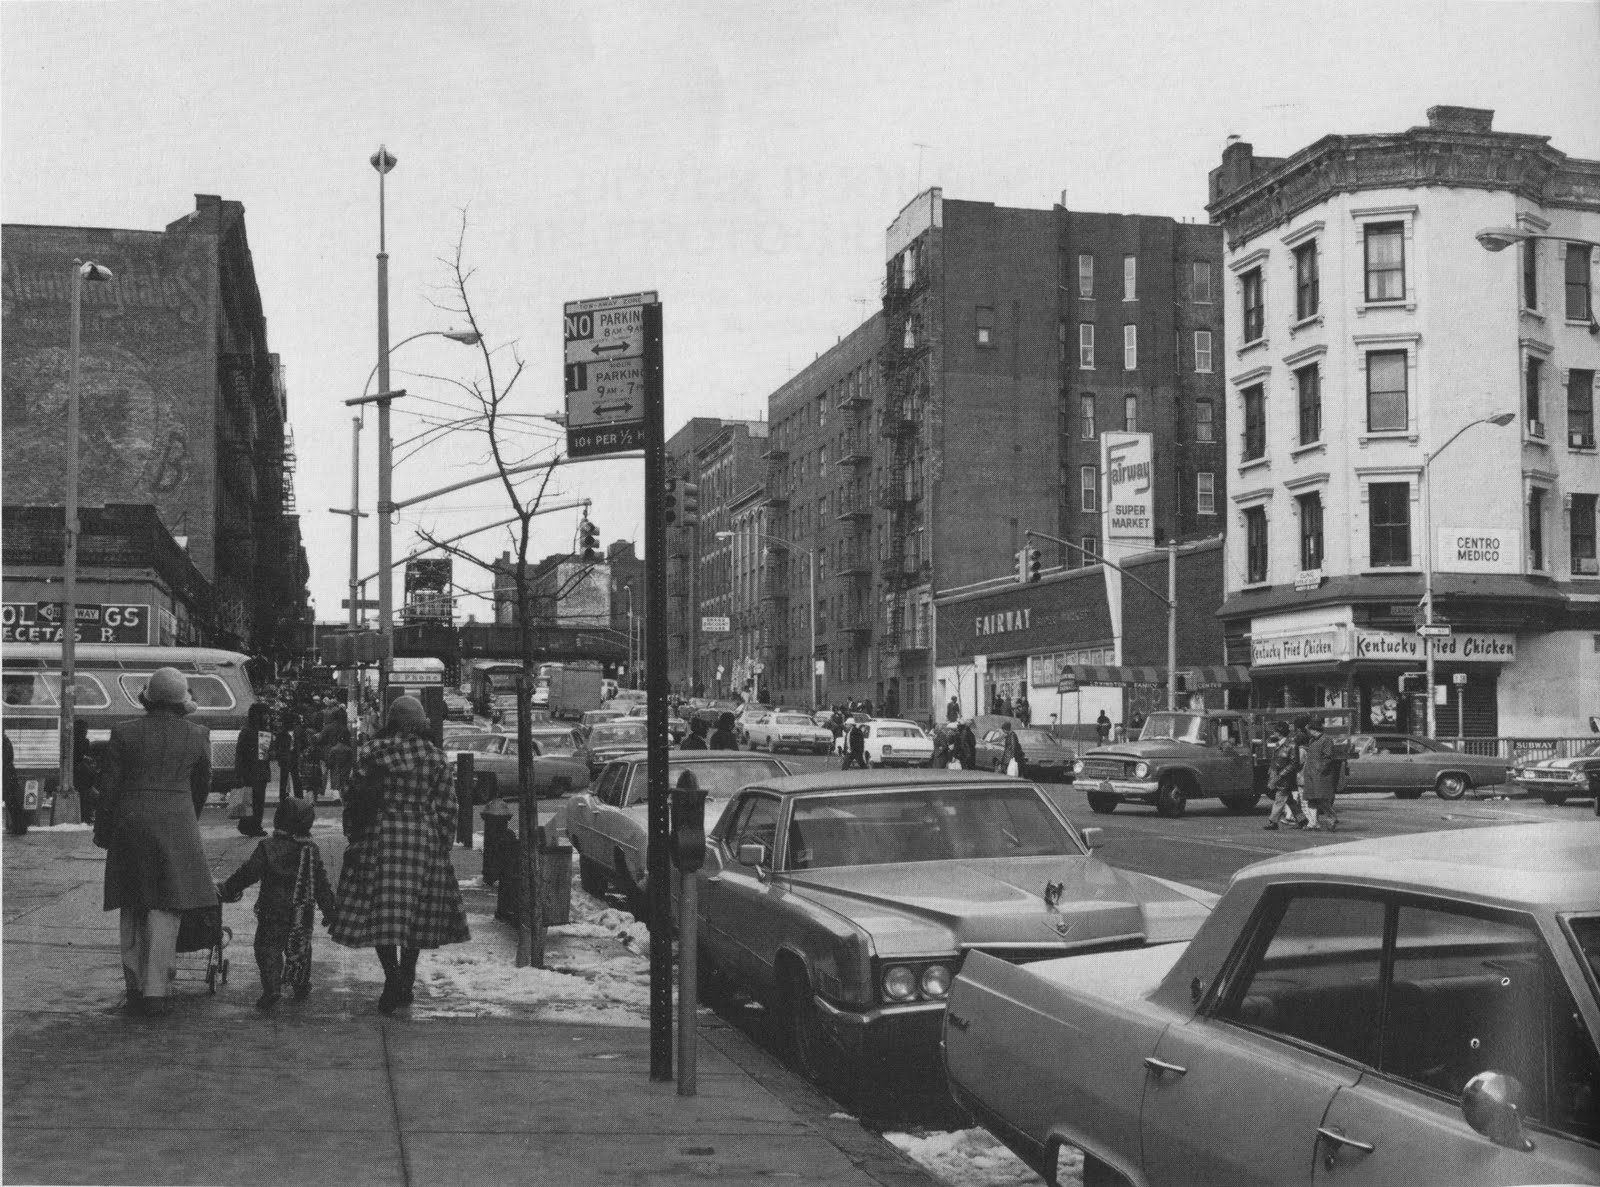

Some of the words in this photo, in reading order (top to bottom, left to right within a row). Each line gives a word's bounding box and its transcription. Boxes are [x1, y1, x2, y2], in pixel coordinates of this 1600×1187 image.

[566, 315, 591, 338] NO
[600, 310, 643, 326] PARKIN
[573, 365, 579, 390] 1
[595, 434, 617, 445] PER
[1106, 440, 1151, 503] Fairway
[1115, 505, 1146, 515] SUPER
[1112, 518, 1150, 528] MARKET
[1457, 537, 1500, 549] CENTRO
[1457, 550, 1500, 561] MEDICO
[976, 608, 1032, 637] FAIRWAY
[1283, 641, 1301, 660] Fried
[1303, 640, 1333, 659] Chicken
[1357, 636, 1417, 657] Kentucky
[1463, 637, 1514, 657] Chicken
